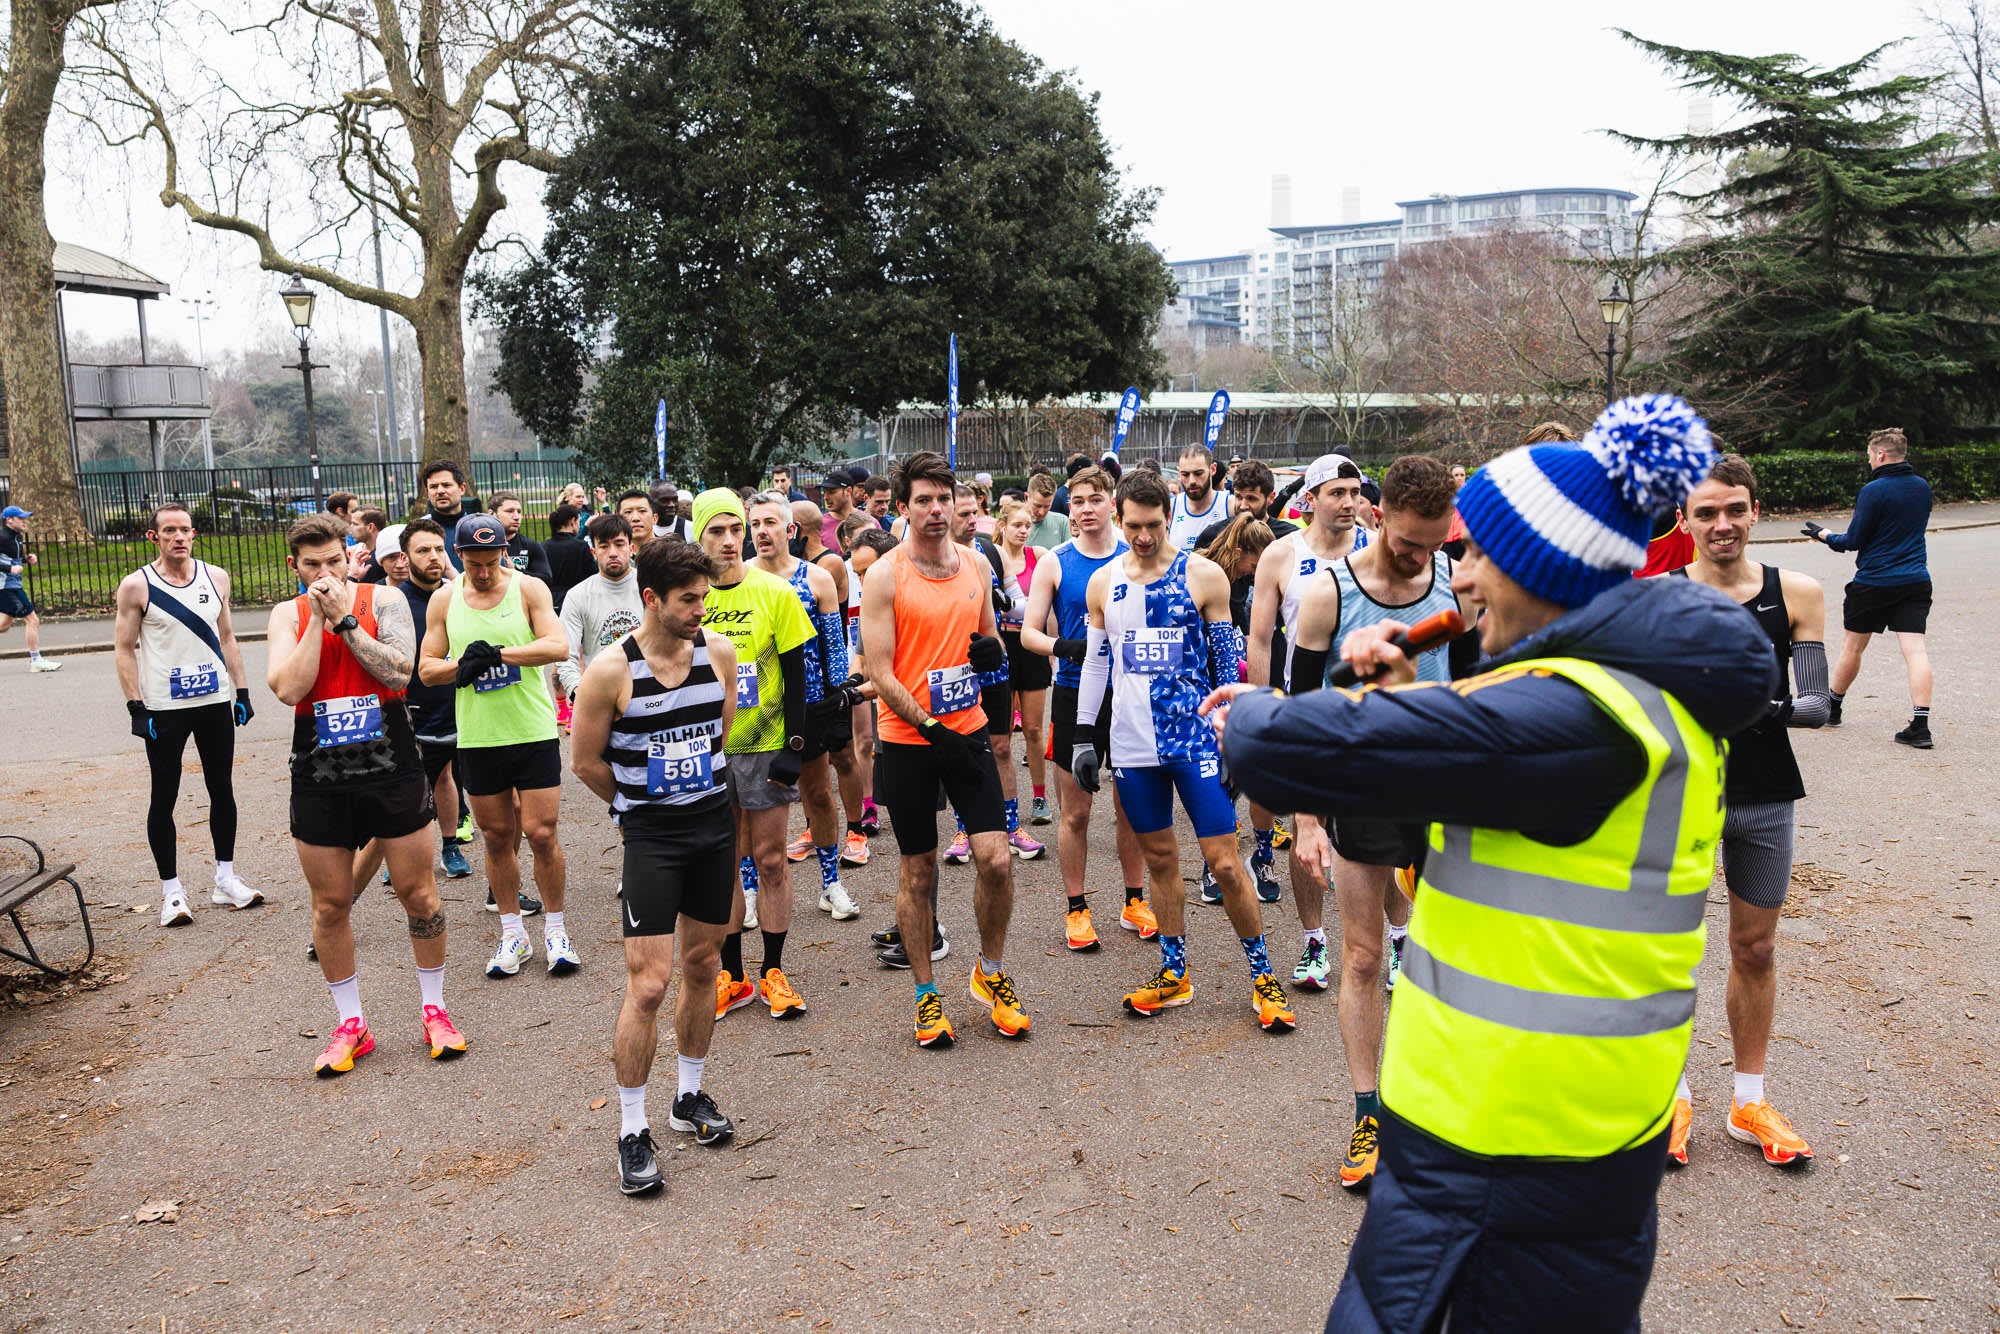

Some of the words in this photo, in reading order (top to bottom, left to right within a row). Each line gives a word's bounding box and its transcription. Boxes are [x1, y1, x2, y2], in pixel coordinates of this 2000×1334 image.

[1157, 630, 1178, 640] 10K
[1135, 643, 1169, 662] 551
[197, 663, 214, 672] 10K
[180, 674, 211, 690] 522
[941, 678, 974, 702] 524
[351, 697, 375, 709] 10K
[644, 699, 664, 709] soar
[327, 710, 368, 733] 527
[649, 722, 716, 744] FULHAM
[688, 738, 708, 753] 10K
[663, 756, 703, 781] 591
